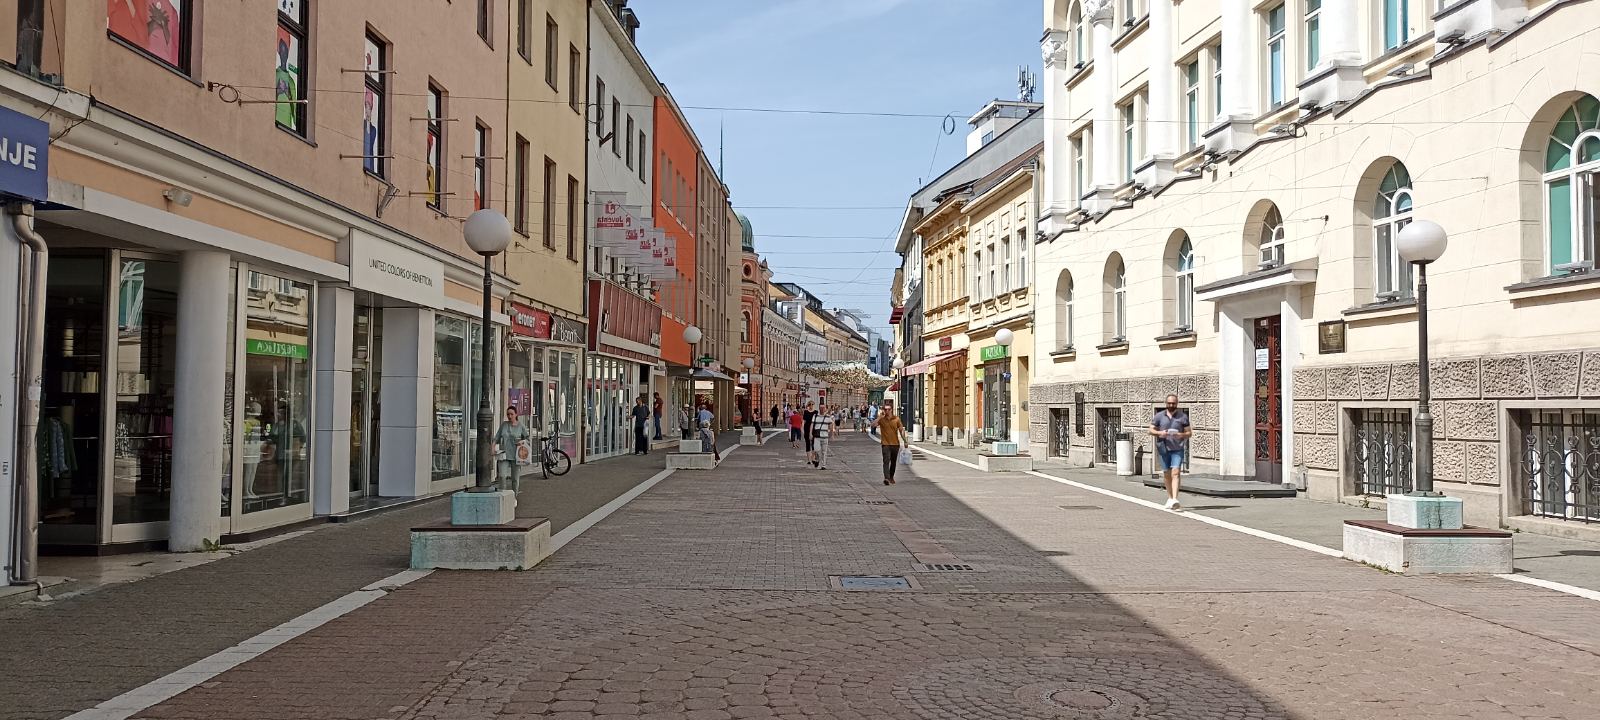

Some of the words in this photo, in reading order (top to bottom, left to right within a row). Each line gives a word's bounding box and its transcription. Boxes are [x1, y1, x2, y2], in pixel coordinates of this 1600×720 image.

[0, 137, 37, 170] NJE
[368, 257, 386, 273] UNITED
[387, 263, 406, 279] COLORS
[411, 271, 433, 287] BENETTON
